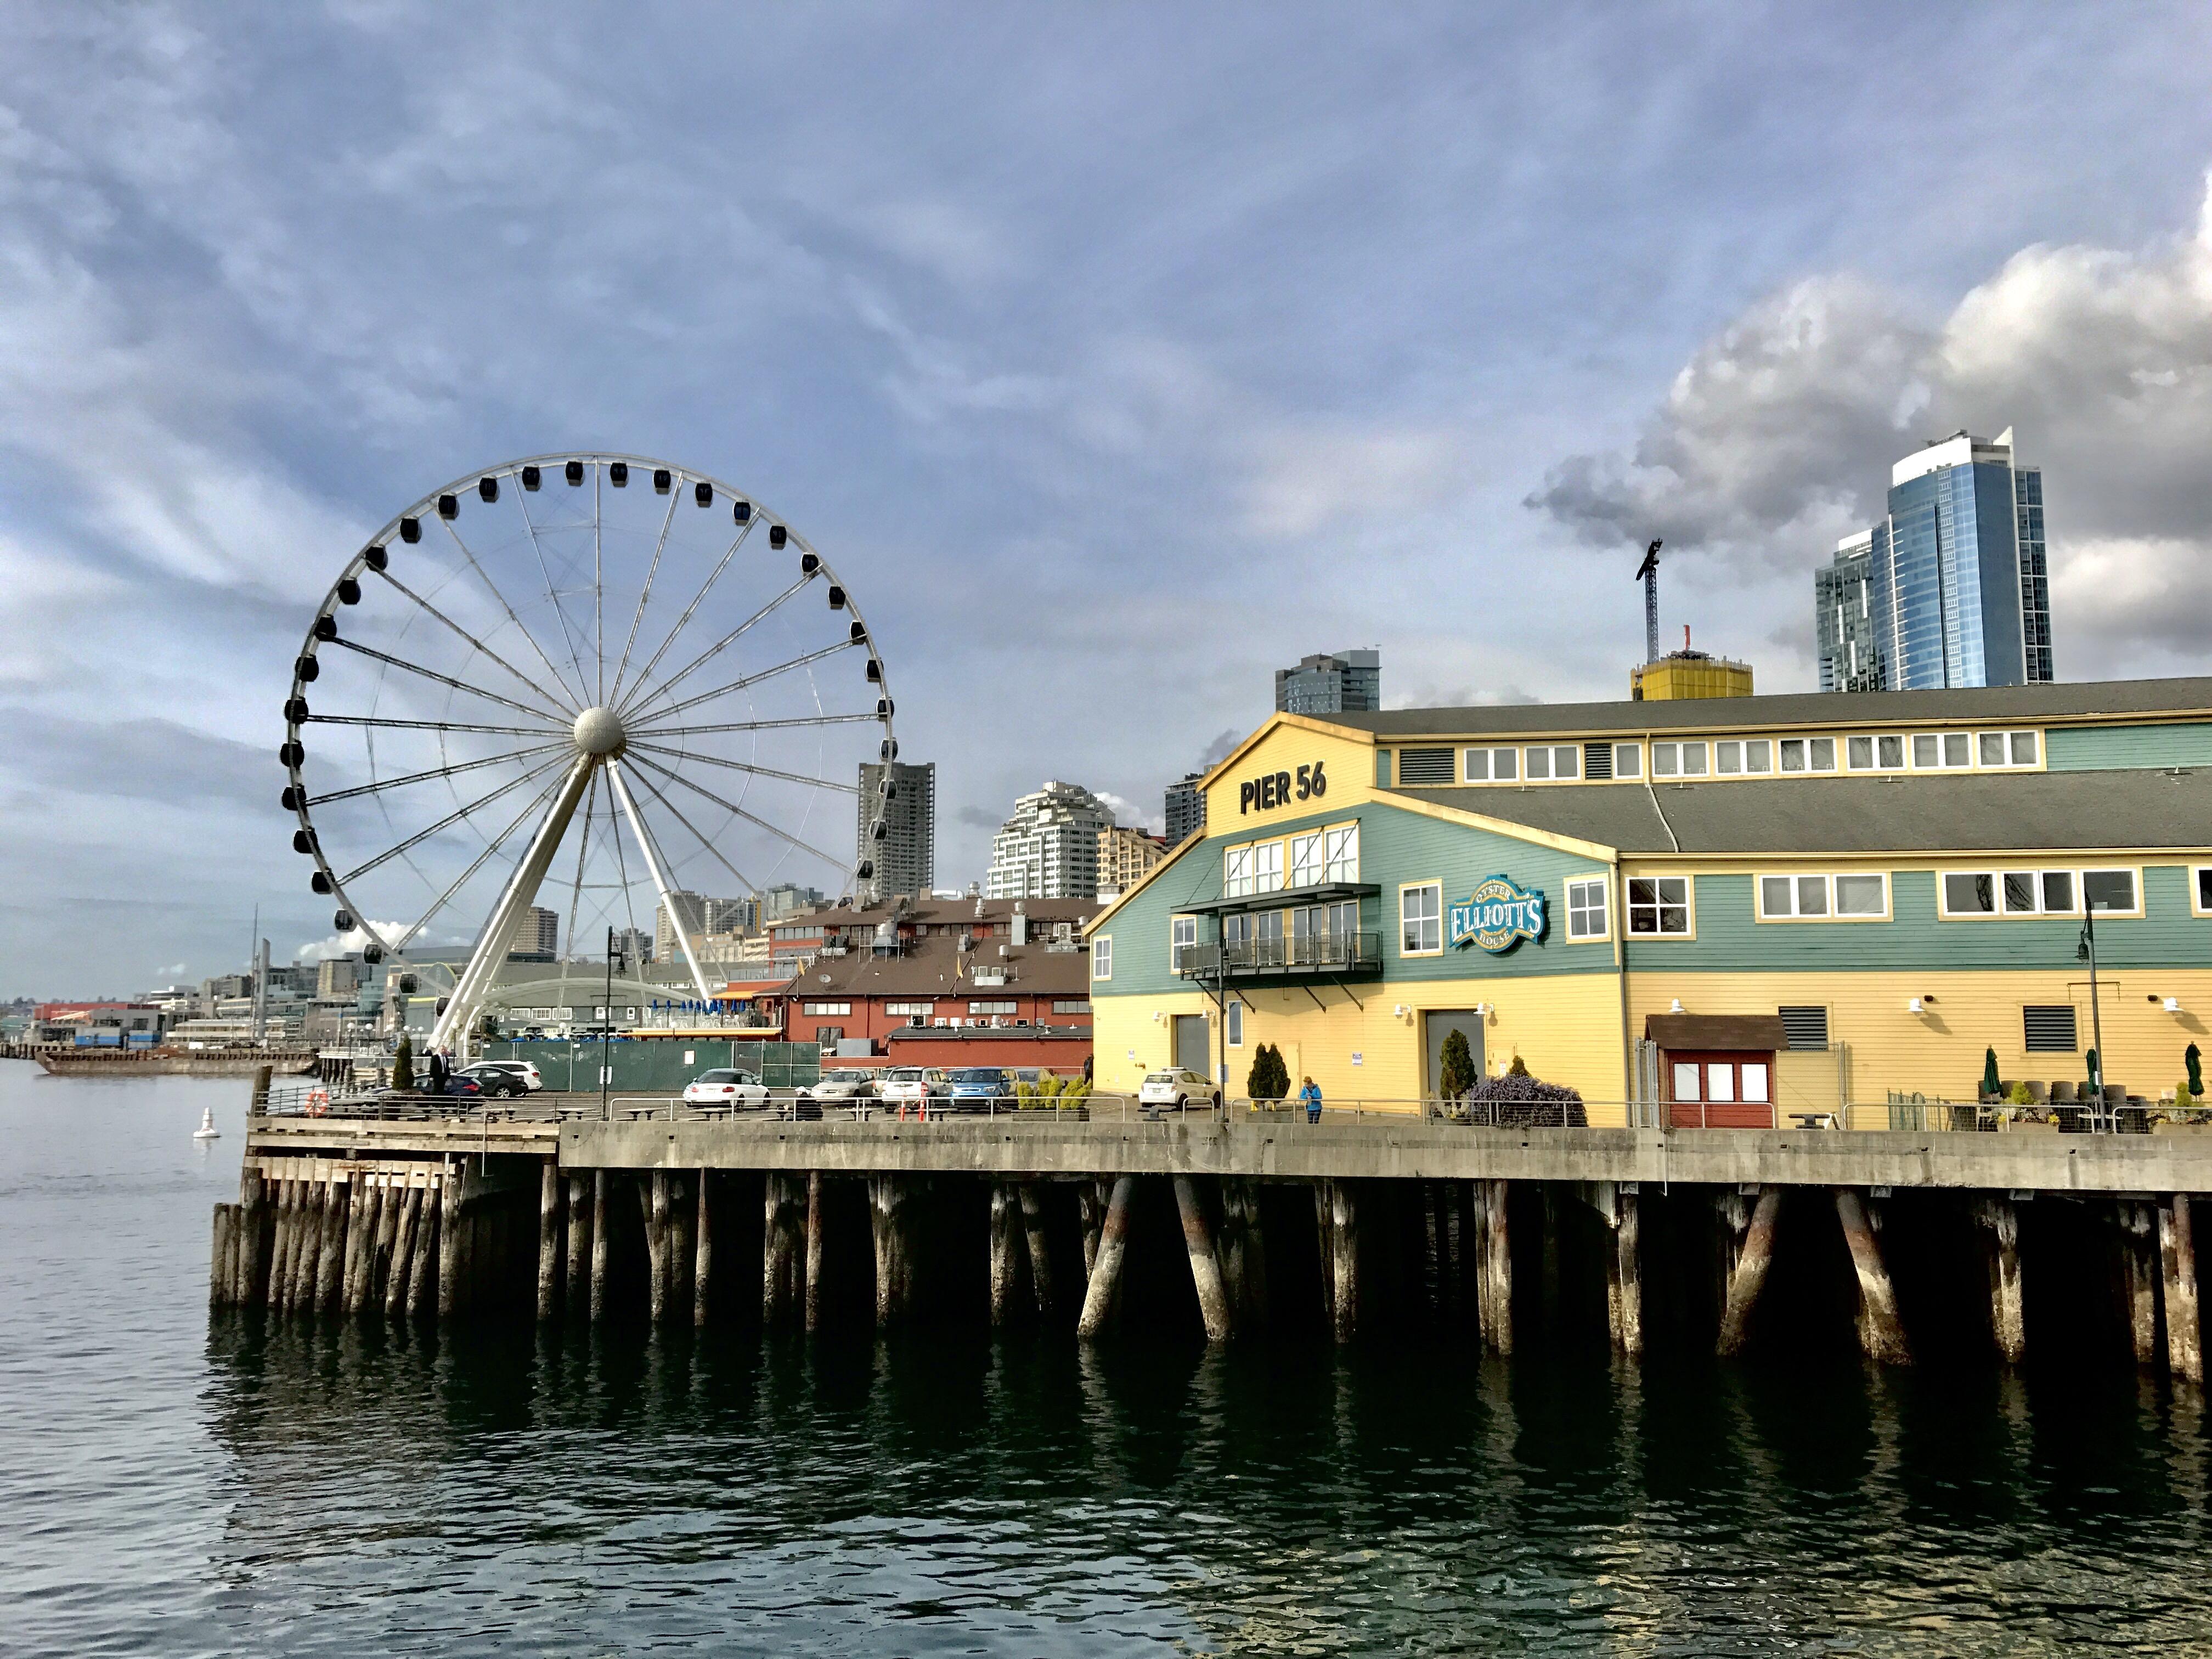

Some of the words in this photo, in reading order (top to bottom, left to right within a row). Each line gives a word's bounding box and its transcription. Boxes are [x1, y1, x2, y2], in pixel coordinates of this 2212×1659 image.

[1240, 771, 1291, 815] PIER
[1296, 760, 1327, 801] 56
[1476, 884, 1510, 904] OYSTER
[1479, 930, 1510, 946] HOUSE
